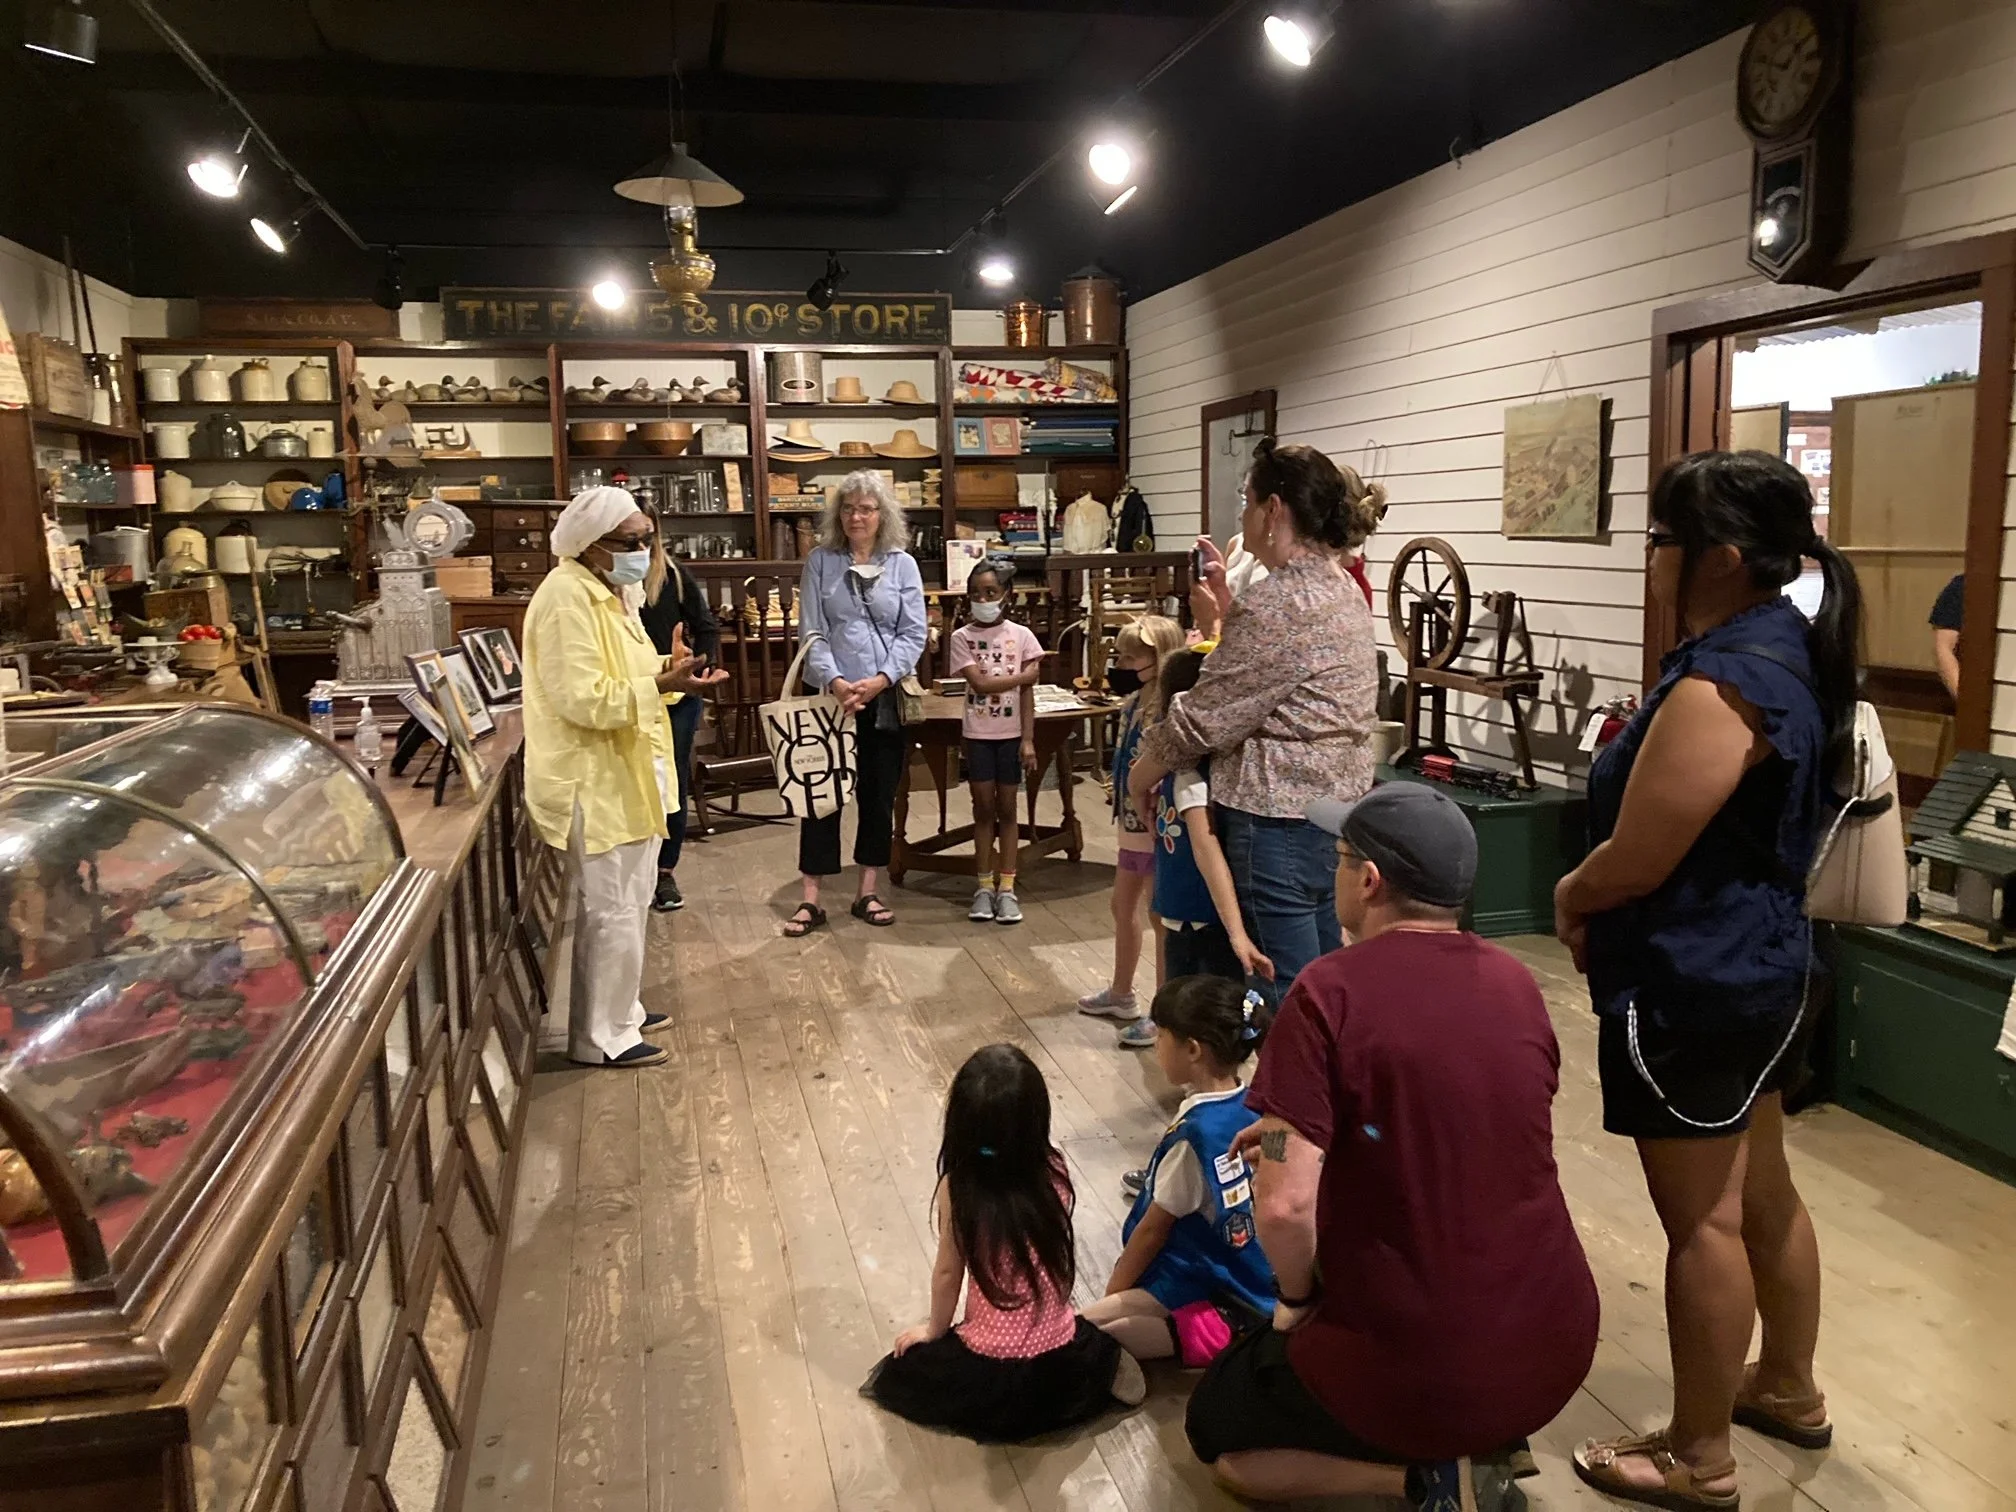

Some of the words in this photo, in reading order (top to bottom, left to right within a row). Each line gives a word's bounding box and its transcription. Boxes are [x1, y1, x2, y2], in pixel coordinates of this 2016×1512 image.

[456, 300, 543, 336] THE
[645, 302, 673, 335] 5
[682, 303, 718, 337] &
[767, 705, 846, 748] NEW
